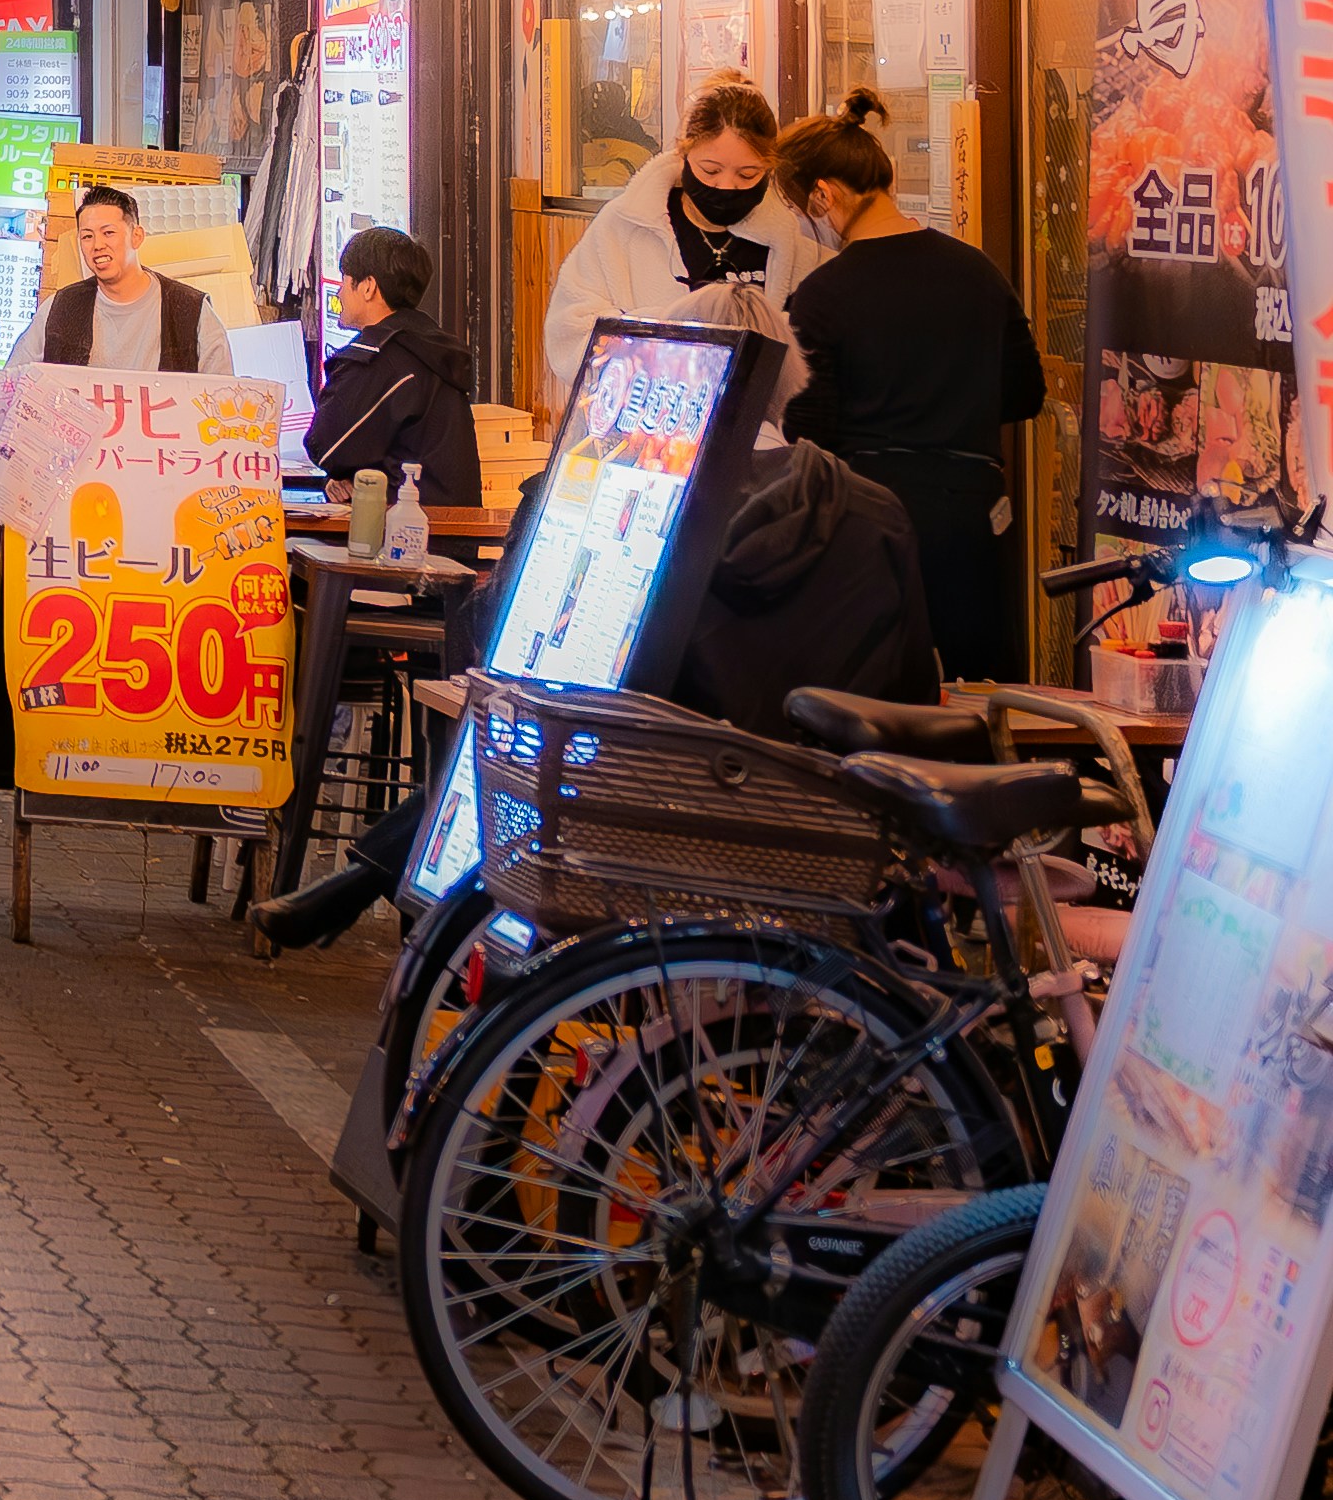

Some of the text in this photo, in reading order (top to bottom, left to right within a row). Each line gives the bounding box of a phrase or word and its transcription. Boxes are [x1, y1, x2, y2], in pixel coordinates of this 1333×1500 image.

[6, 37, 67, 49] 24時間営業
[6, 76, 71, 85] 60分 2,000円
[6, 90, 71, 99] 90分 2,500円
[0, 144, 53, 163] ルーム
[11, 167, 44, 195] 8
[954, 127, 970, 238] 営業中
[1129, 167, 1219, 262] 全品
[1255, 286, 1293, 344] 税込
[68, 383, 181, 440] サヒ
[94, 445, 281, 482] パードライ(中)
[28, 535, 205, 586] 生ビール
[235, 573, 285, 600] 何杯
[237, 599, 287, 616] 飲んでも
[164, 732, 287, 761] 税込275円
